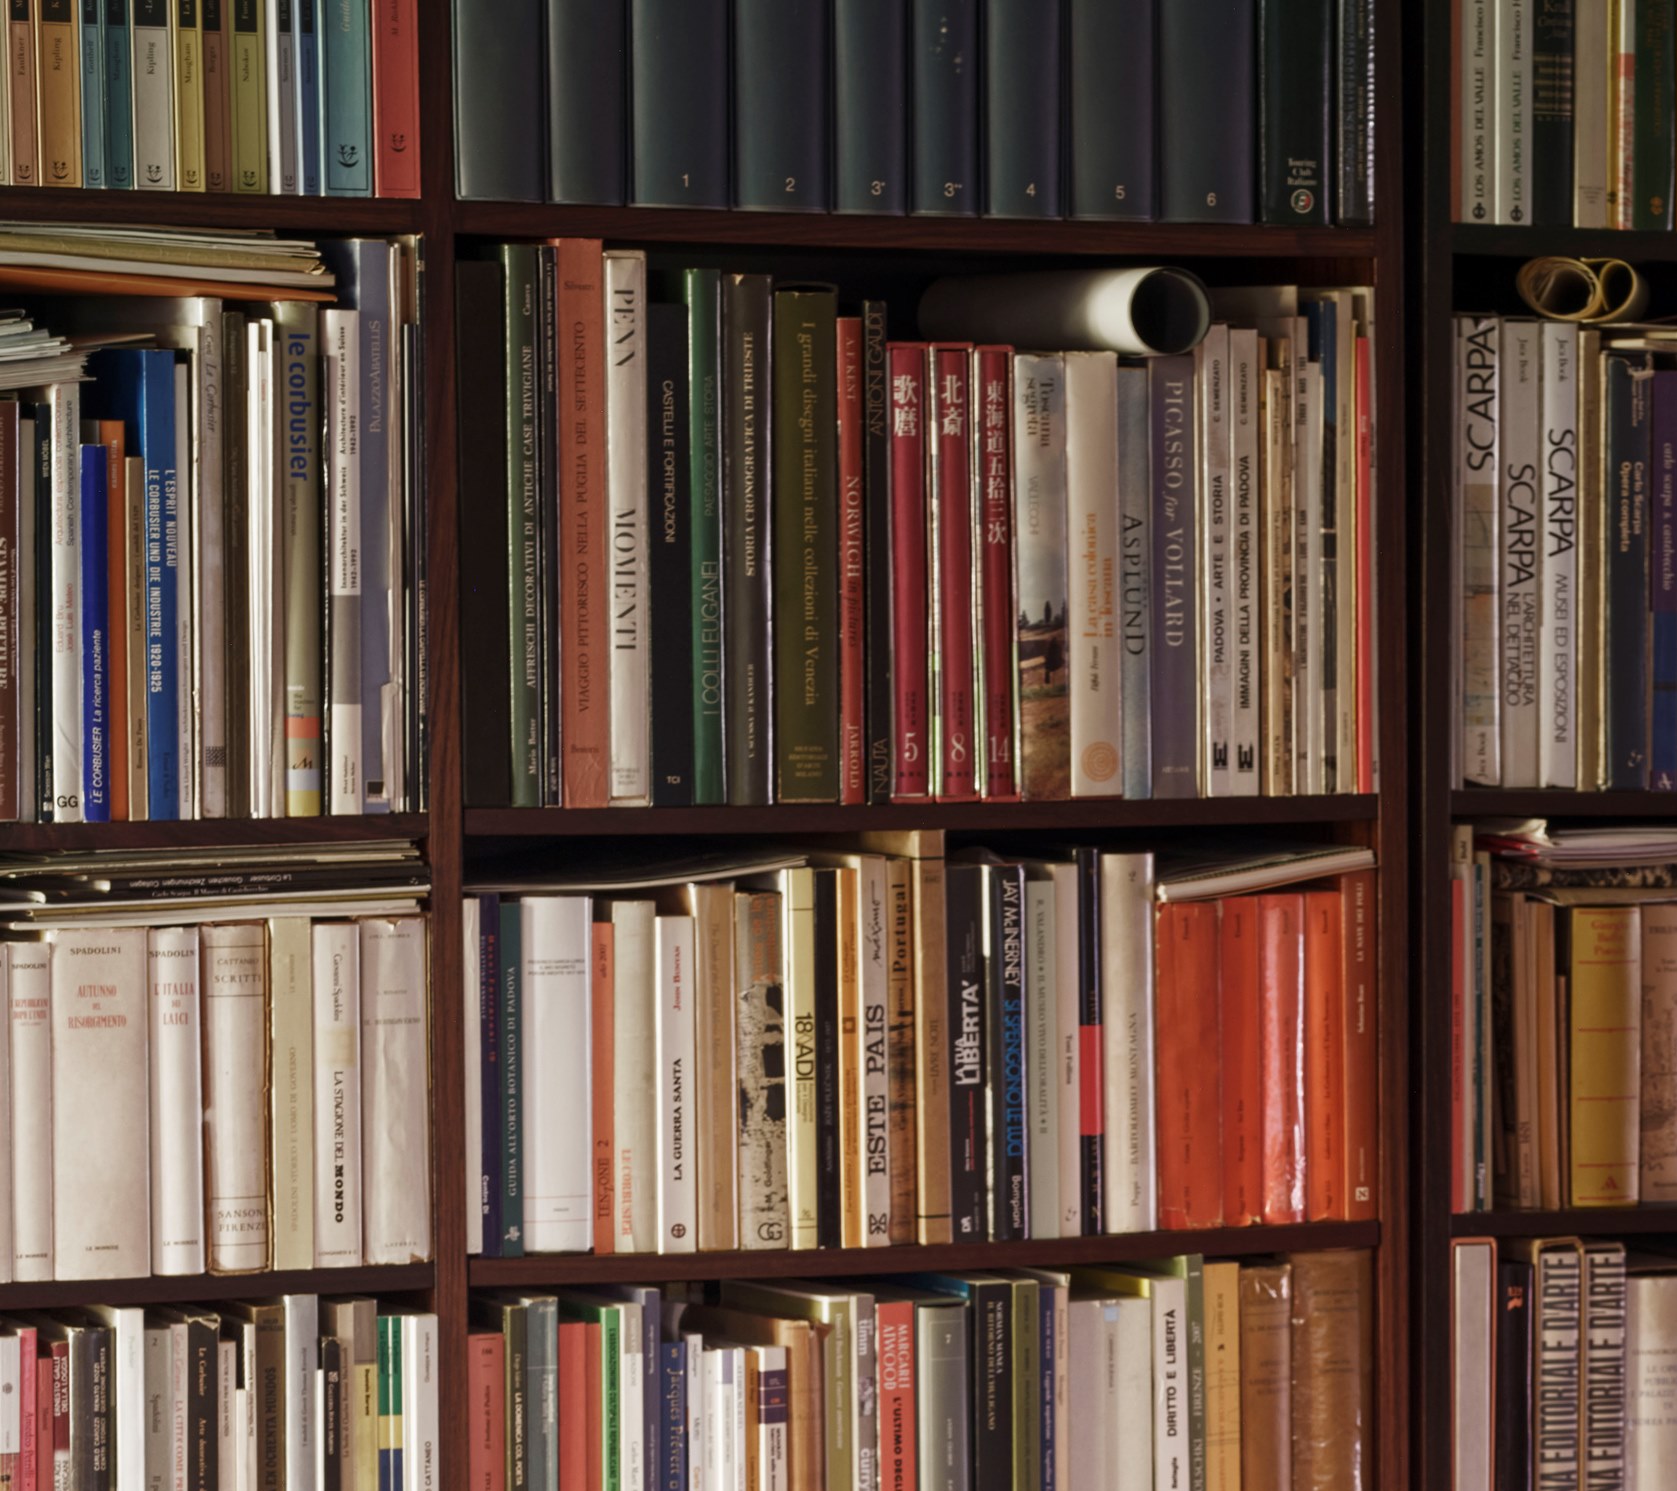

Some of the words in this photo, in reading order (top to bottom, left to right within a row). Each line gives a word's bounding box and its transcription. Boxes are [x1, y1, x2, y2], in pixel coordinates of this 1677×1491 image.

[52, 36, 62, 70] Kipling
[146, 40, 156, 74] Kipling
[682, 175, 689, 188] 1
[784, 178, 796, 193] 2
[1025, 184, 1036, 197] 4
[1115, 185, 1125, 200] 5
[1205, 192, 1217, 207] 6
[288, 332, 309, 350] le
[613, 289, 634, 368] PENN
[574, 320, 585, 411] SETTECENTO
[801, 333, 812, 381] grandi
[288, 361, 307, 479] corbusier
[663, 380, 673, 436] CASTELLI
[802, 388, 813, 442] disegni
[893, 374, 918, 437] 歌麿
[1467, 326, 1495, 471] SCARPA
[575, 417, 586, 444] DEL
[1165, 381, 1182, 488] PICASSO
[66, 452, 74, 510] Contemporary
[148, 469, 159, 480] LE
[575, 453, 587, 502] PUGLIA
[803, 448, 815, 500] italiani
[985, 380, 1007, 545] 東海道五拾三次
[148, 484, 160, 539] CORBUSIER
[663, 451, 675, 543] FORTIFICAZIONI
[1164, 492, 1176, 521] for
[1547, 428, 1574, 556] SCARPA
[65, 514, 74, 546] Spanish
[576, 510, 587, 554] NELLA
[803, 506, 816, 545] nelle
[1507, 464, 1534, 587] SCARPA
[148, 542, 160, 562] UND
[149, 566, 161, 582] DIE
[576, 561, 589, 646] PITTORESCO
[615, 509, 636, 650] MOMENTI
[701, 560, 717, 642] EUGANEI
[804, 548, 815, 620] collezioni
[1124, 514, 1142, 655] ASPLUND
[1165, 528, 1183, 646] VOLLARD
[1554, 572, 1568, 620] MUSEI
[149, 586, 161, 637] INDUSTRIE
[1506, 592, 1519, 618] NEL
[92, 628, 101, 670] paziente
[805, 626, 817, 641] di
[1522, 592, 1534, 705] L'ARCHITETTURA
[1554, 626, 1567, 647] ED
[93, 672, 102, 706] ricerca
[150, 643, 162, 692] 1920-1925
[578, 652, 589, 712] VIAGGIO
[701, 647, 718, 704] COLLI
[804, 646, 817, 705] Venezia
[1506, 624, 1519, 706] DETTAGLIO
[92, 708, 102, 721] La
[1553, 653, 1567, 743] ESPOSIZIONI
[92, 726, 102, 788] CORBUSIER
[903, 733, 919, 762] 5
[949, 733, 967, 761] 8
[988, 735, 1010, 763] 14
[92, 788, 102, 803] LE
[1003, 879, 1018, 903] JAY
[69, 945, 122, 956] SPADOLINI
[1003, 907, 1019, 986] McINERNEY
[77, 985, 117, 998] AUTUNNO
[67, 1016, 127, 1029] RISORGIMENTO
[866, 1004, 884, 1074] PAIS
[334, 1070, 343, 1084] LA
[672, 1058, 681, 1102] SANTA
[334, 1086, 343, 1136] STAGIONE
[673, 1106, 681, 1160] GUERRA
[868, 1094, 885, 1173] ESTE
[335, 1140, 343, 1160] DEL
[673, 1164, 681, 1181] LA
[334, 1164, 343, 1222] MONDO
[1542, 1254, 1579, 1329] D'ARTE
[1165, 1309, 1175, 1364] LIBERTÀ
[1166, 1370, 1176, 1378] E
[1539, 1334, 1578, 1462] EDITORIALE
[1167, 1386, 1176, 1436] DIRITTO
